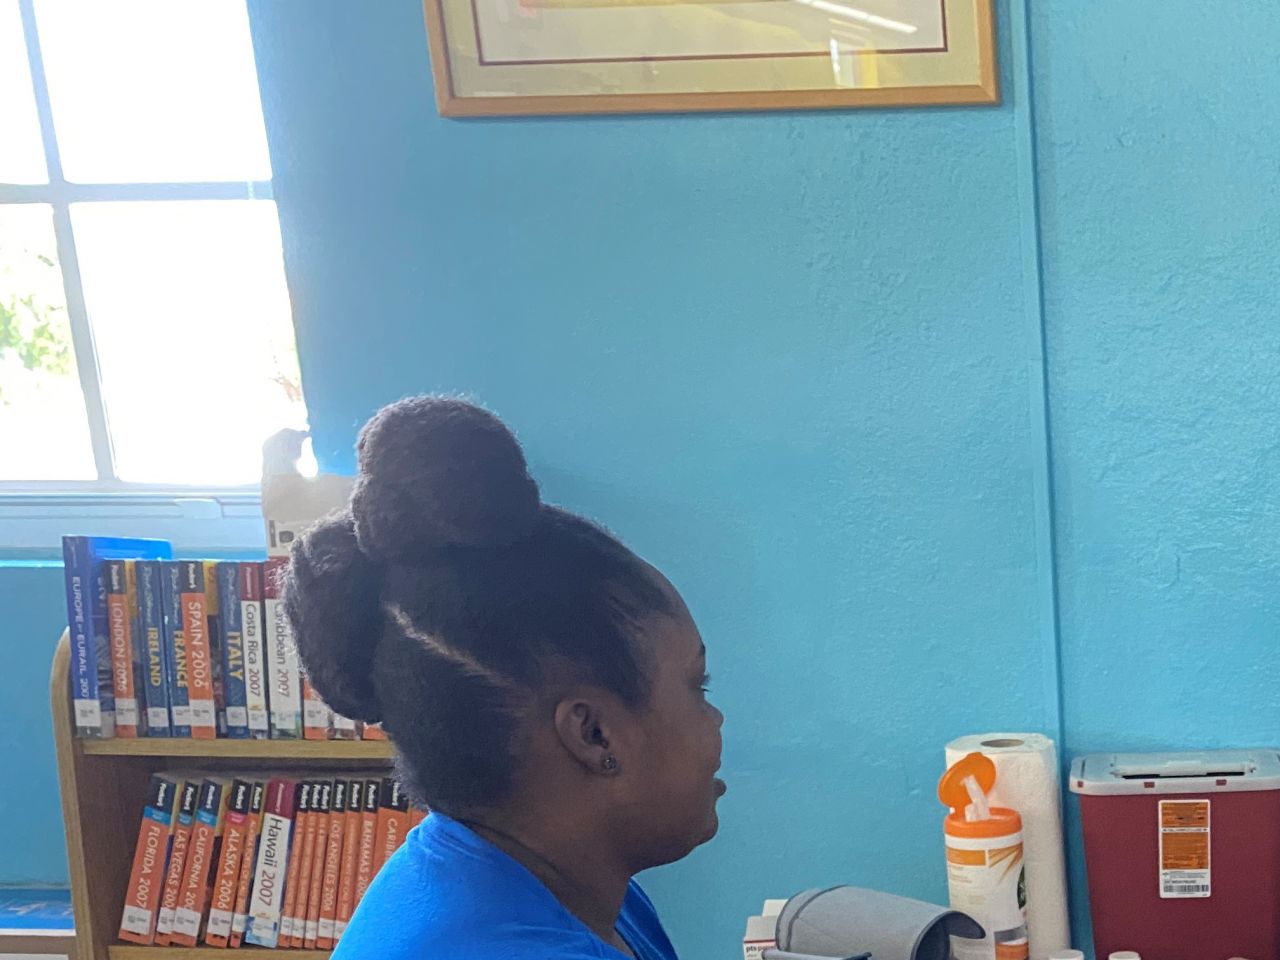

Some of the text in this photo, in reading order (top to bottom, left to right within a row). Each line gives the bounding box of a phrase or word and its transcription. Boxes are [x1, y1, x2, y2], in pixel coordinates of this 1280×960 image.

[72, 576, 90, 700] EUROPE EURAIL 200
[111, 602, 127, 658] LONDON
[147, 627, 163, 687] IRELAND
[173, 630, 188, 688] FRANCE
[188, 601, 209, 689] SPAIN 2006
[226, 631, 244, 682] ITALY
[245, 603, 261, 697] Costa Rica 2007
[276, 669, 291, 698] 2007
[135, 825, 161, 909] FLORIDA 2007
[165, 828, 188, 909] LAS VEGAS 200
[188, 827, 209, 889] CALIFORNIA
[217, 828, 240, 910] ALASKA 2006
[258, 817, 282, 907] Hawaii 2007
[325, 841, 340, 886] ANGELES
[359, 820, 374, 874] BAHAMAS
